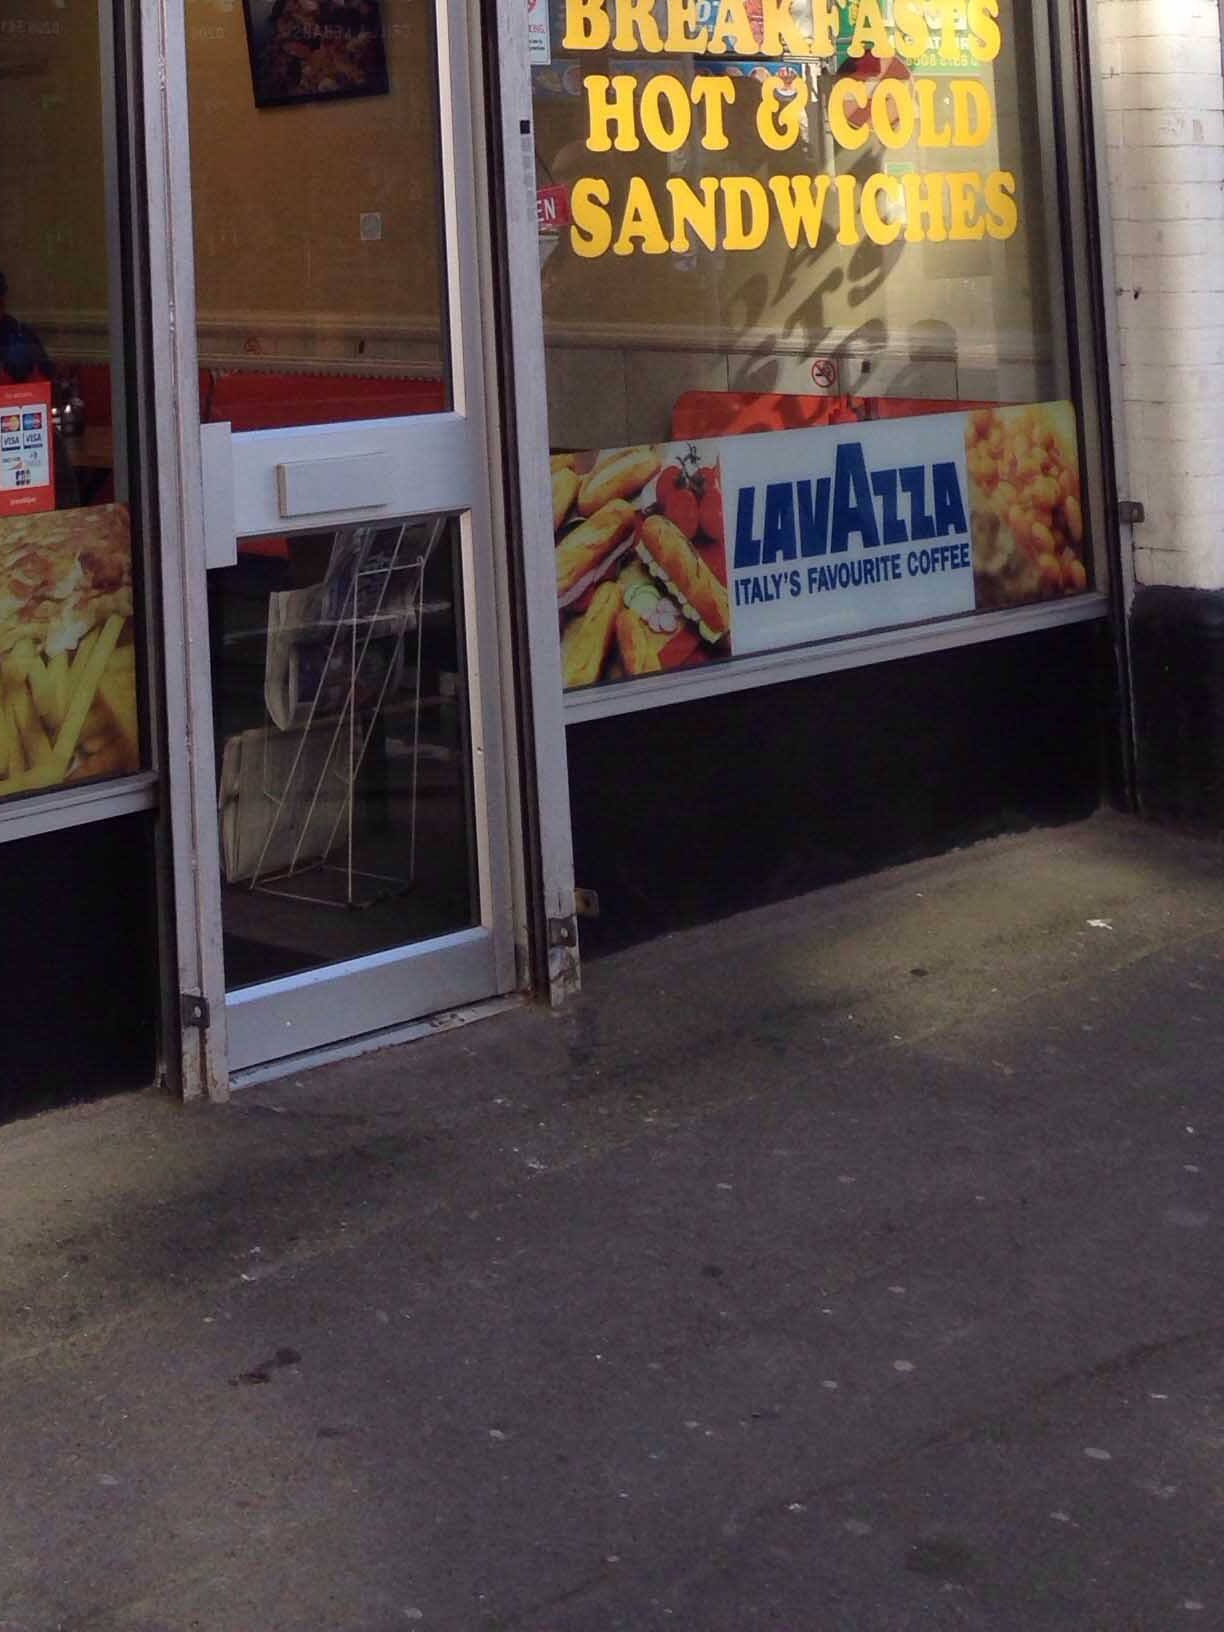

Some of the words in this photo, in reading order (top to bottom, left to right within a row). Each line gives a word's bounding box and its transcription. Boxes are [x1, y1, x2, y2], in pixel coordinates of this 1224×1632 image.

[583, 75, 735, 153] HOT
[756, 77, 808, 150] &
[828, 77, 993, 150] COLD
[536, 197, 556, 222] EN
[570, 169, 1018, 258] SANDWICHES
[733, 443, 968, 568] LAVAZZA
[734, 573, 802, 607] ITALY'S
[808, 553, 902, 595] FAVOURITE
[908, 542, 971, 577] COFFEE
